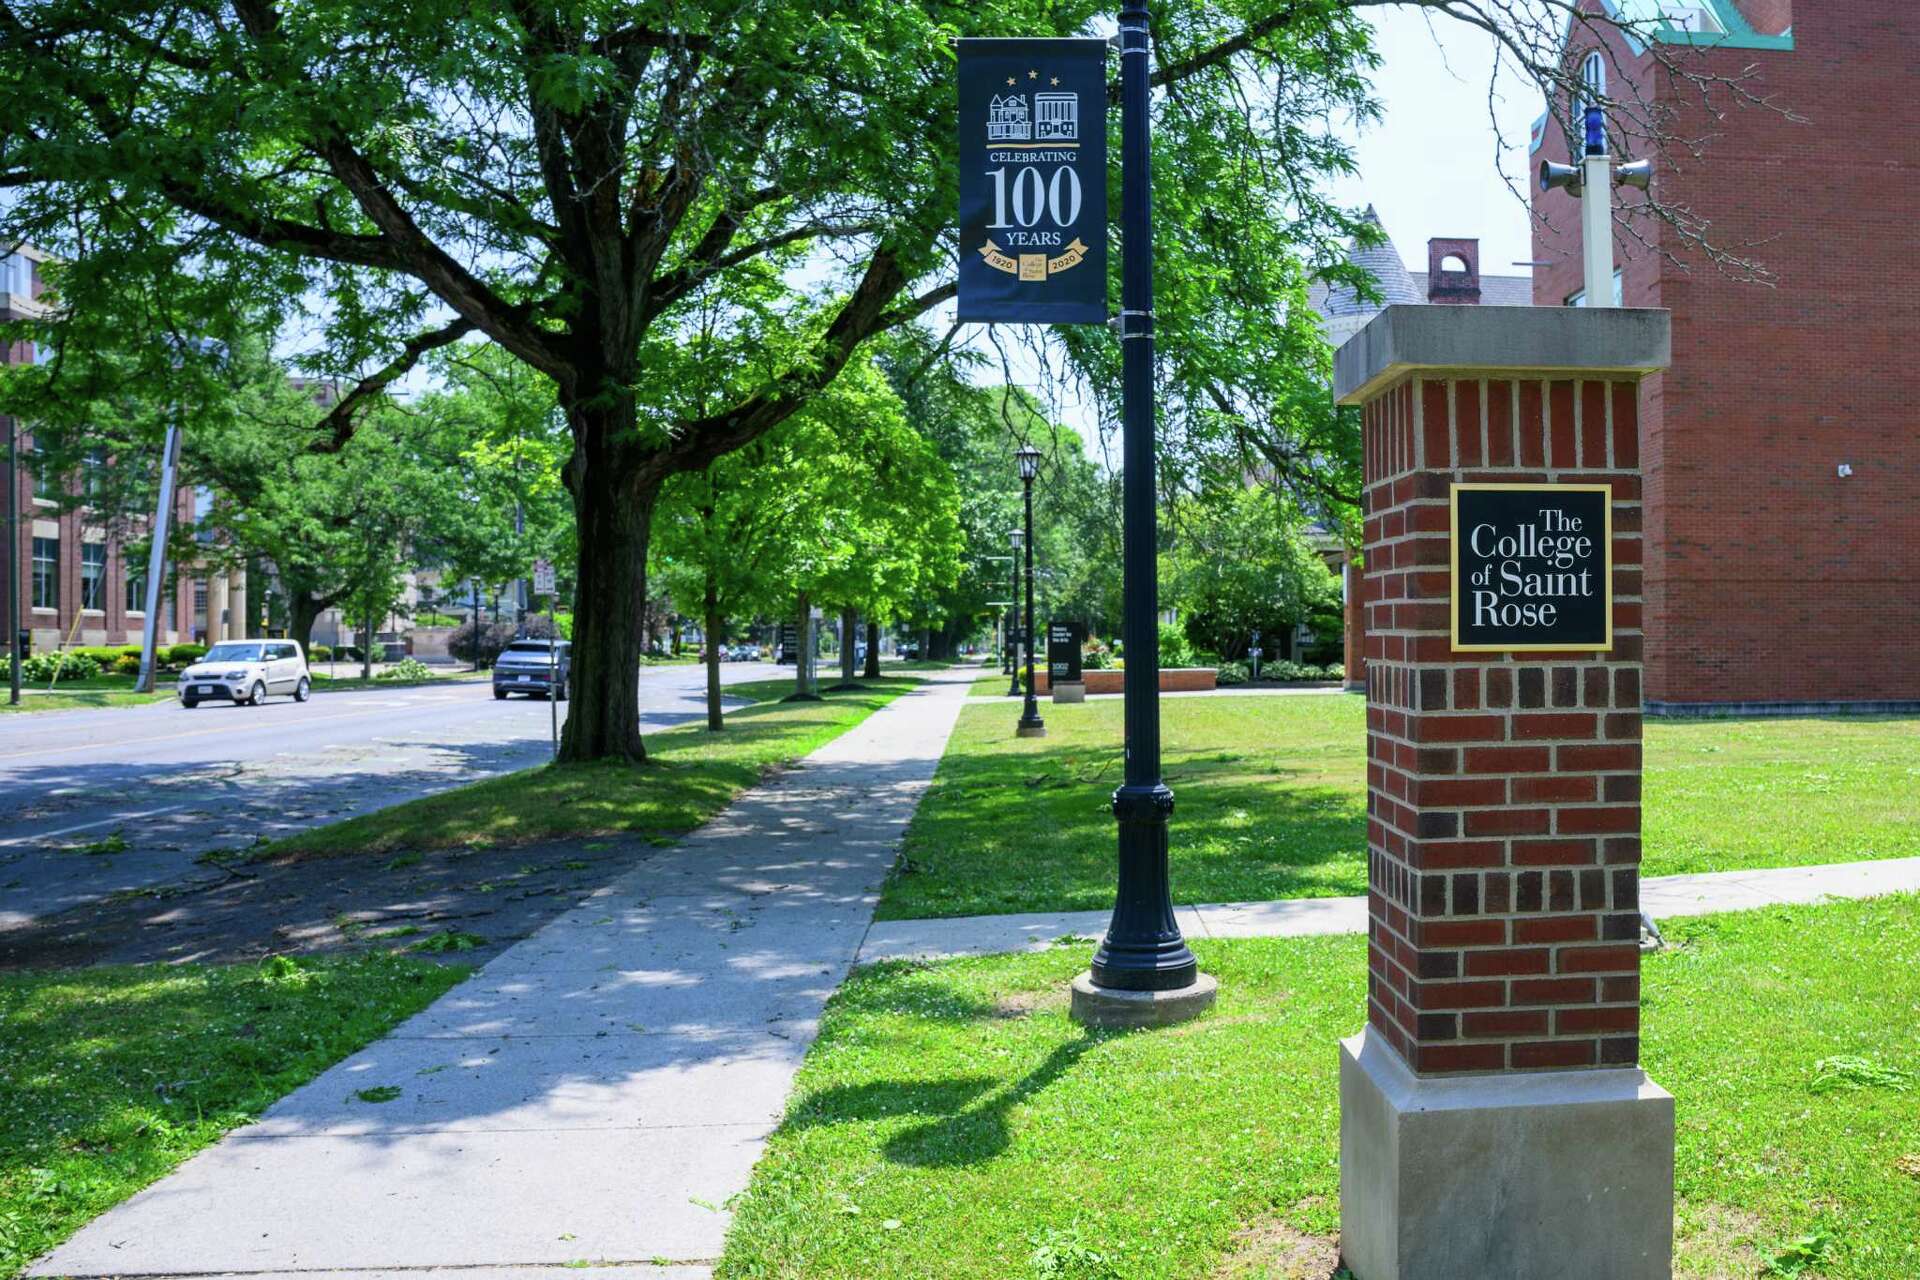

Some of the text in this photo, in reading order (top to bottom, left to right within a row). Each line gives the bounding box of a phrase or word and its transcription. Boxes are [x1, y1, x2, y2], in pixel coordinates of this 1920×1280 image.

[990, 151, 1077, 162] CELEBRATING
[985, 165, 1082, 228] 100
[1006, 231, 1061, 246] YEARS
[992, 256, 1013, 269] 1920
[1052, 255, 1076, 269] 2020
[1538, 509, 1583, 532] The
[1470, 523, 1592, 569] College
[1471, 559, 1593, 597] of Saint
[1471, 590, 1557, 627] Rose
